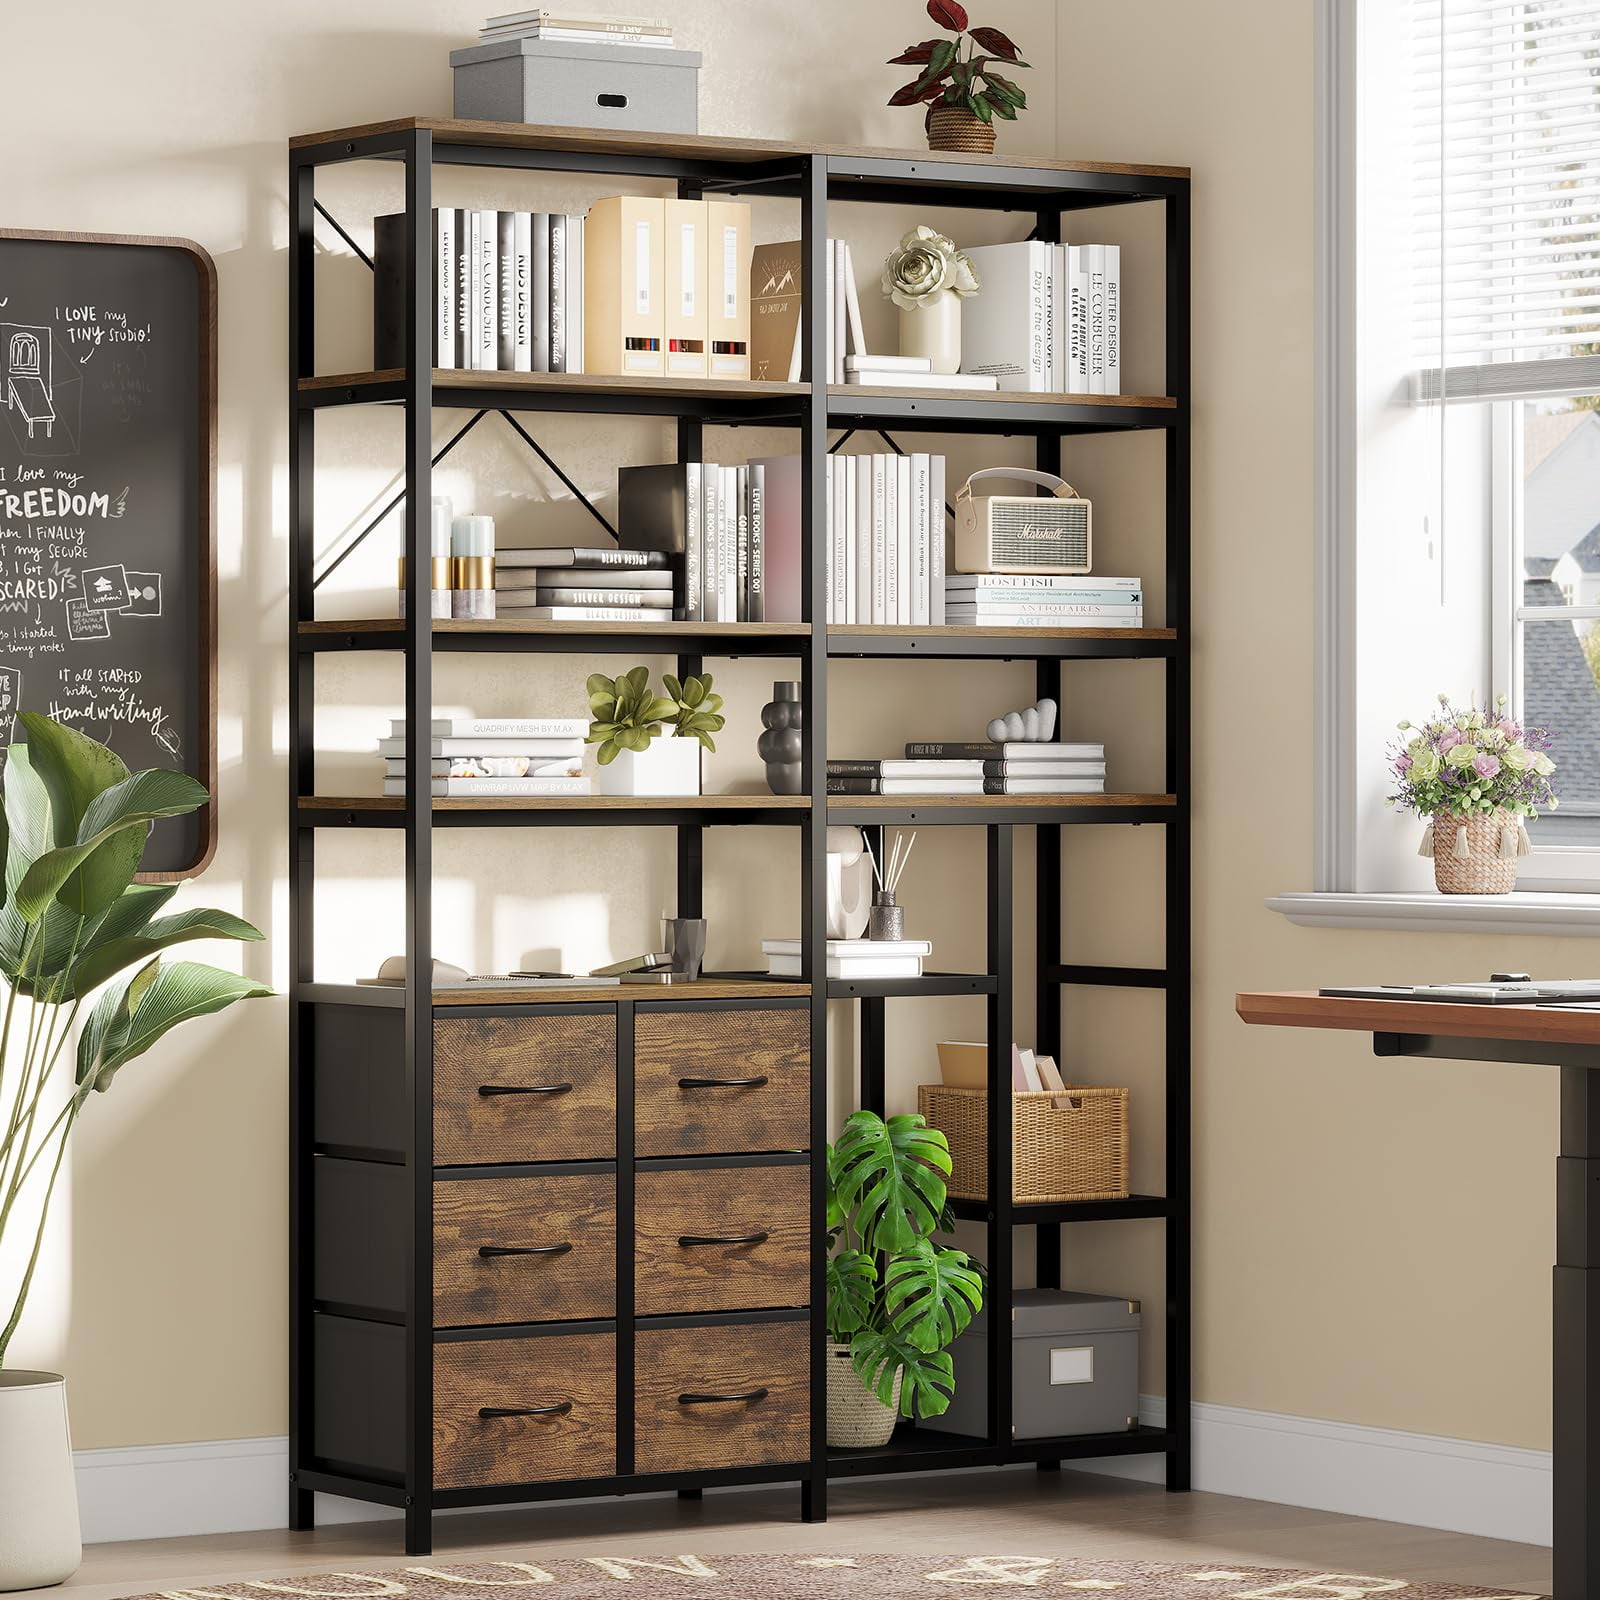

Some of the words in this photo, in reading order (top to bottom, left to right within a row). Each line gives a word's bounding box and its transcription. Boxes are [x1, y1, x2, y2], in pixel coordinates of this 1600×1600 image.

[501, 255, 512, 291] SILVER
[518, 254, 529, 288] KIDS
[1032, 271, 1042, 291] Day
[1092, 272, 1103, 290] LE
[1032, 297, 1042, 308] of
[1071, 288, 1079, 318] BLACK
[1108, 282, 1117, 322] BETTER
[65, 305, 97, 321] LOVE
[104, 311, 127, 328] my
[501, 297, 512, 336] DESIGN
[518, 292, 529, 345] DESIGN
[1032, 312, 1042, 331] the
[1071, 323, 1079, 359] DESIGN
[1092, 293, 1103, 376] CORBUSIER
[1108, 325, 1117, 368] DESIGN
[1032, 335, 1042, 373] design
[14, 464, 46, 483] love
[52, 469, 84, 489] my
[707, 487, 715, 512] LEVEL
[752, 488, 761, 513] LEVEL
[707, 513, 715, 542] BOOKS
[738, 515, 747, 547] COFFEE
[752, 514, 761, 544] BOOKS
[1016, 524, 1063, 540] Marshall
[14, 545, 43, 562] my
[48, 543, 88, 559] SECURE
[601, 553, 622, 564] BLACK
[624, 553, 648, 565] DESIGN
[707, 548, 715, 577] SERIES
[738, 549, 747, 577] ATLAS
[752, 549, 761, 577] SERIES
[707, 577, 715, 593] 001
[752, 578, 761, 594] 001
[983, 577, 1020, 587] LOST
[1023, 578, 1053, 587] FISH
[573, 593, 604, 604] SILVER
[608, 593, 641, 604] DESIGN
[20, 625, 57, 639] started
[1016, 617, 1042, 625] ART
[7, 640, 36, 658] tiny
[40, 641, 65, 652] notes
[75, 668, 92, 682] all
[63, 684, 97, 698] with
[101, 685, 129, 701] my
[47, 693, 169, 736] Handwriting
[473, 724, 515, 733] QUADRIFY
[516, 724, 540, 733] MESH
[541, 724, 552, 733] BY
[554, 724, 573, 733] M.AX
[470, 783, 508, 792] UNWRAP
[510, 783, 528, 792] UVW
[530, 783, 548, 792] MAP
[550, 783, 561, 792] BY
